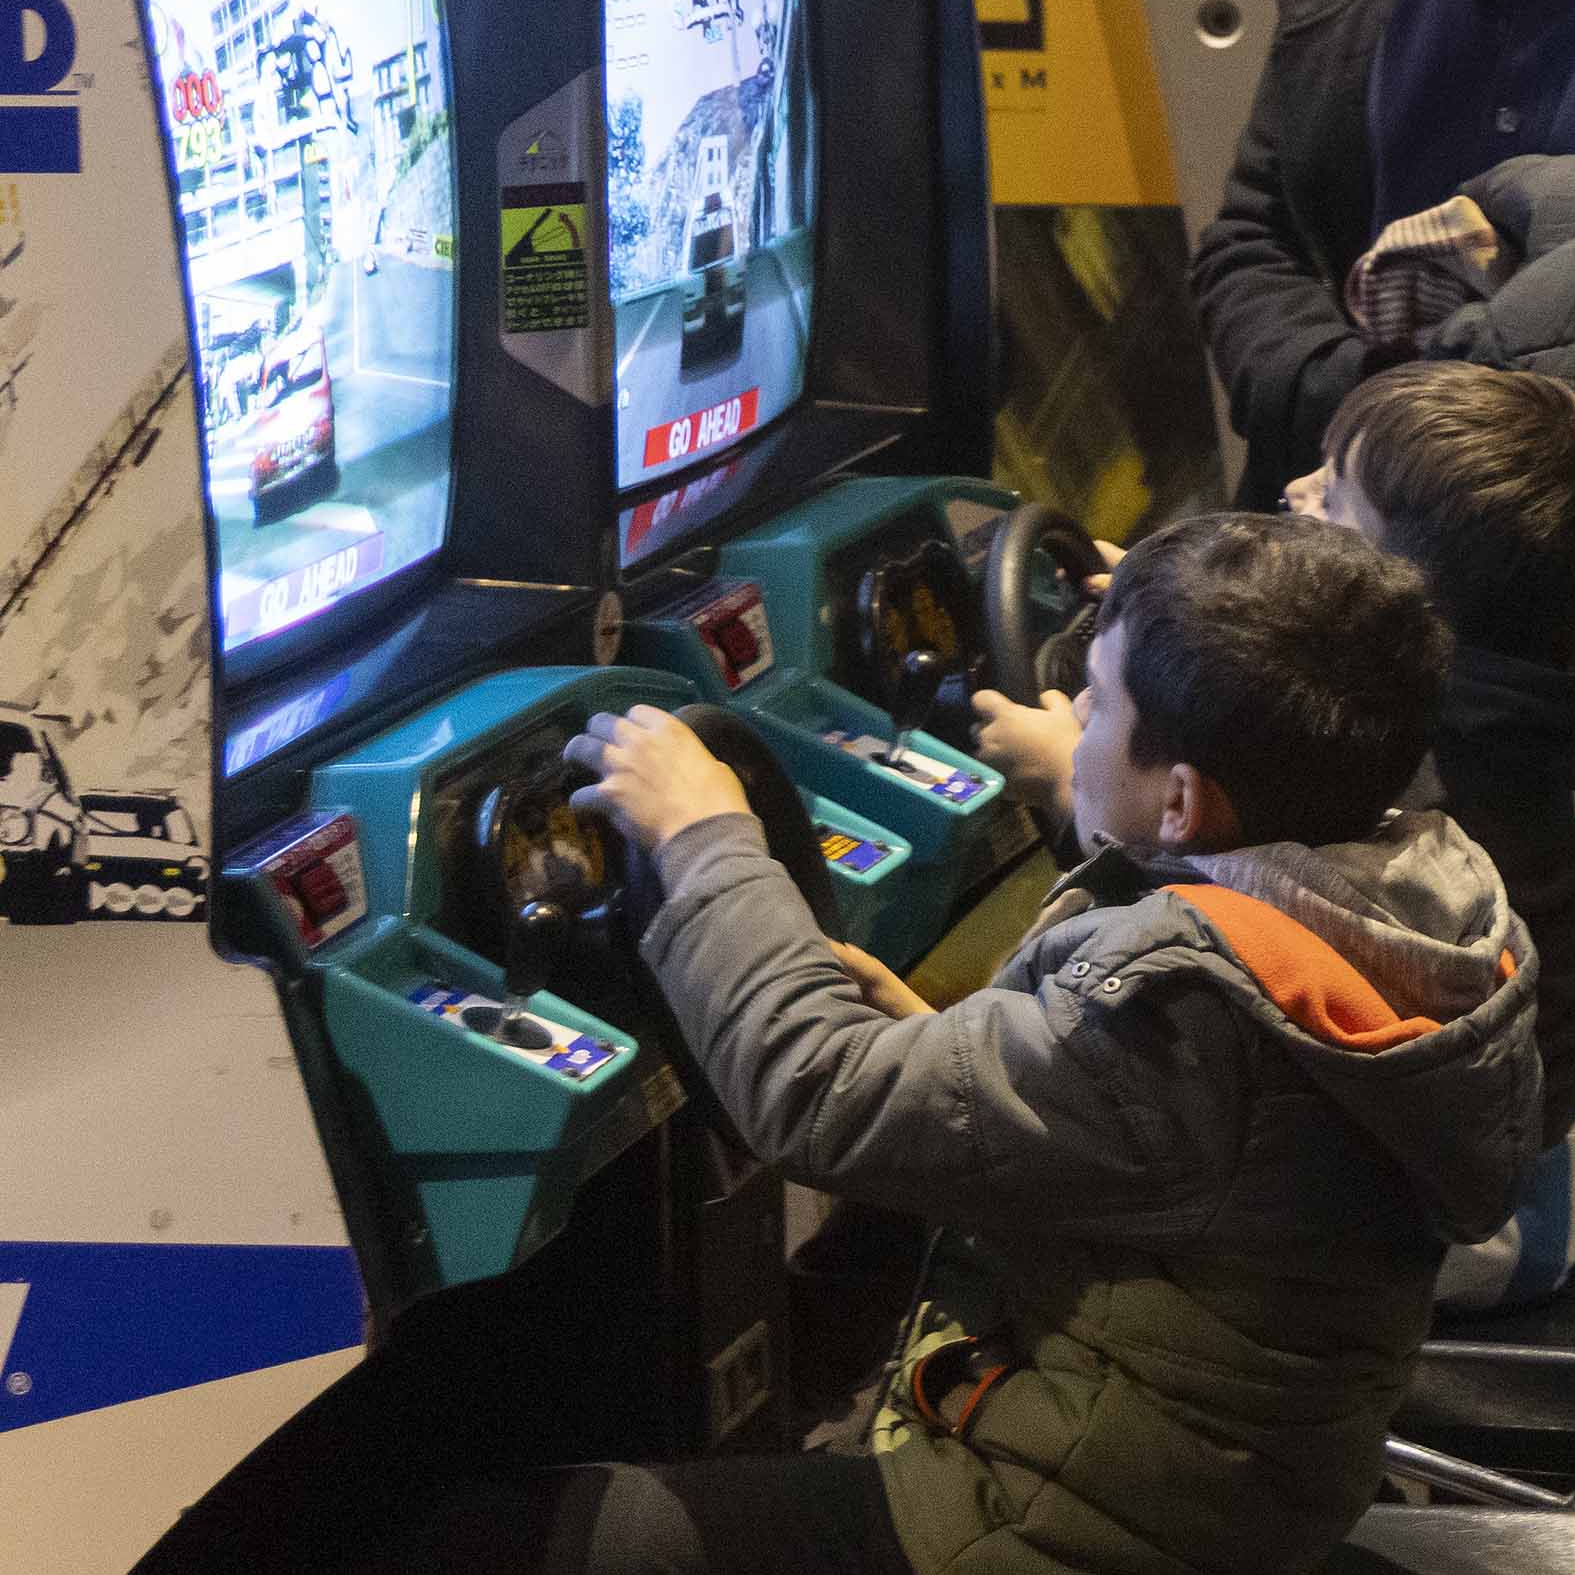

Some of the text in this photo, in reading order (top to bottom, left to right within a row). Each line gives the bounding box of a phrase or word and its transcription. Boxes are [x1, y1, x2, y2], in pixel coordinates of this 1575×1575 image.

[668, 397, 742, 459] GO AHEAD
[261, 546, 358, 614] GO AHEAD
